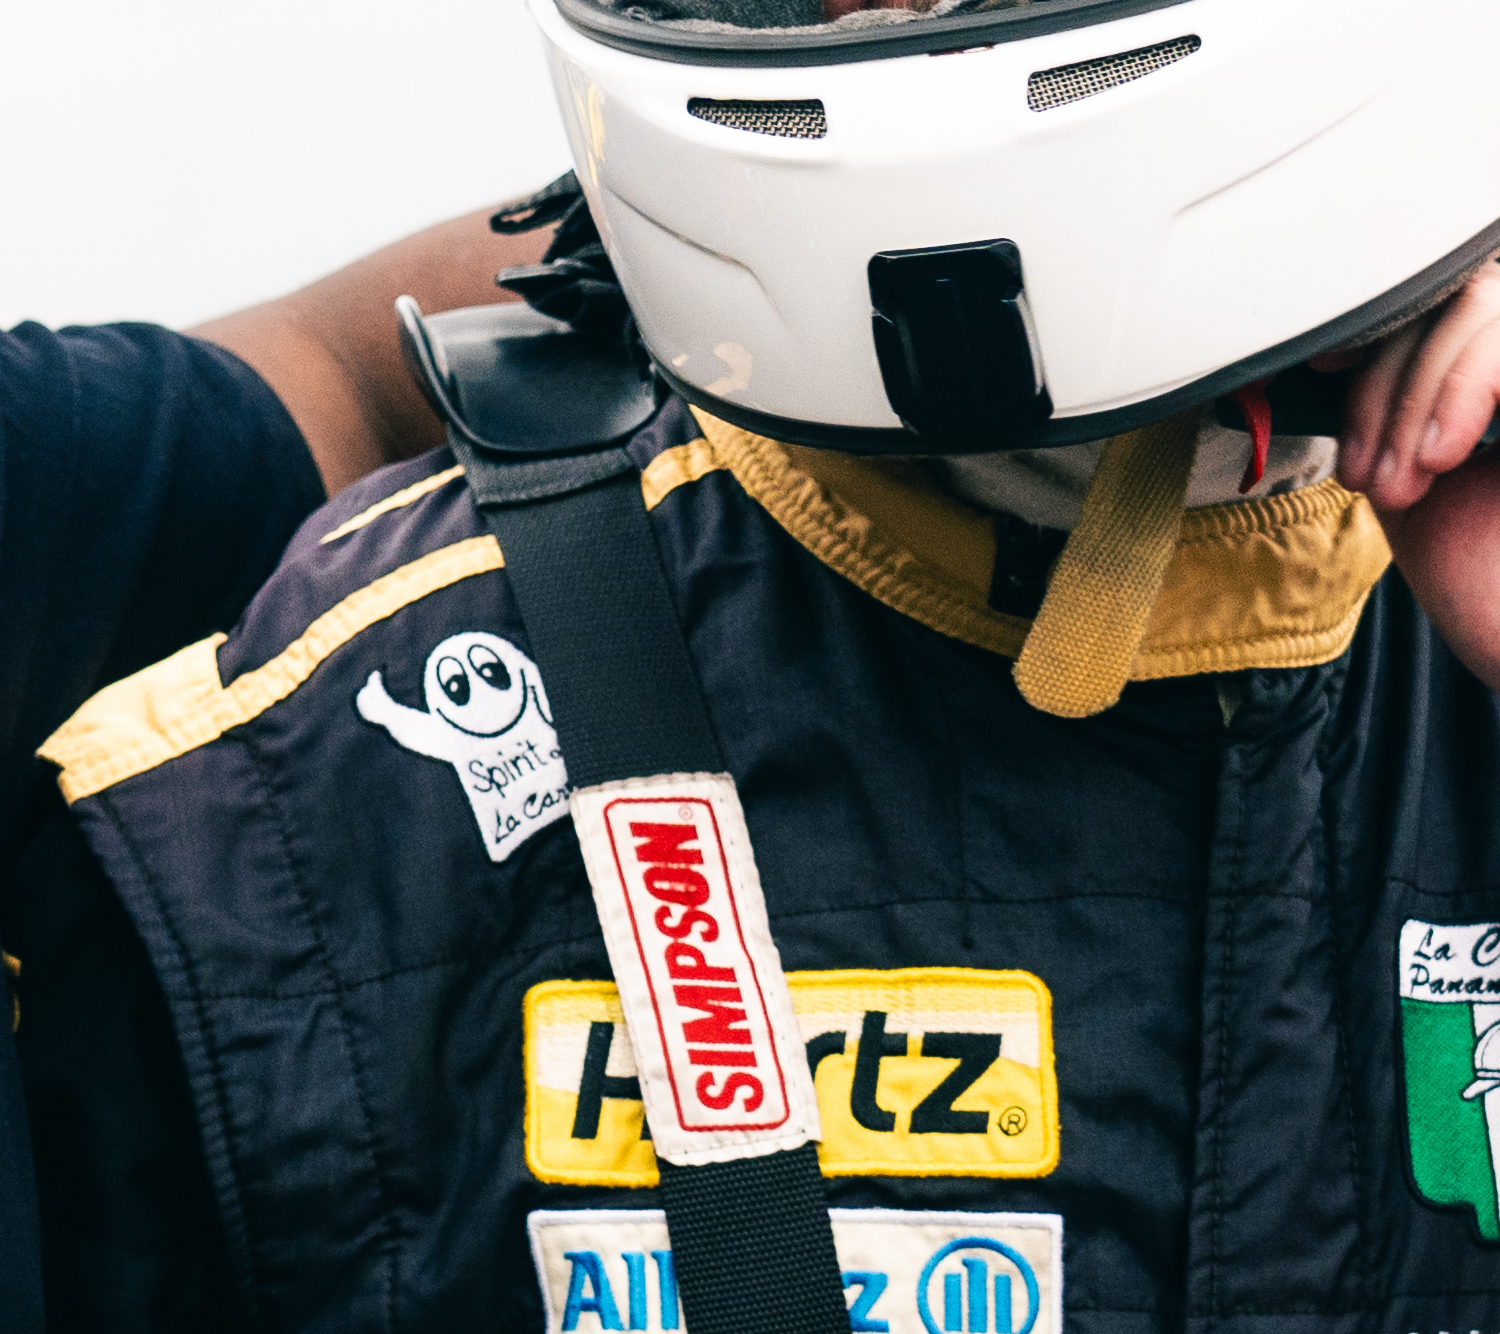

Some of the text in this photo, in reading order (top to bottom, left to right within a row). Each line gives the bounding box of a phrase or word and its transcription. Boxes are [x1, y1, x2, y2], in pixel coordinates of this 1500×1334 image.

[469, 740, 548, 798] Spirit
[495, 809, 520, 844] La
[629, 819, 764, 1114] SIMPSON
[1413, 927, 1455, 961] La
[571, 1010, 1002, 1141] Hrtz
[561, 1249, 890, 1333] Allz
